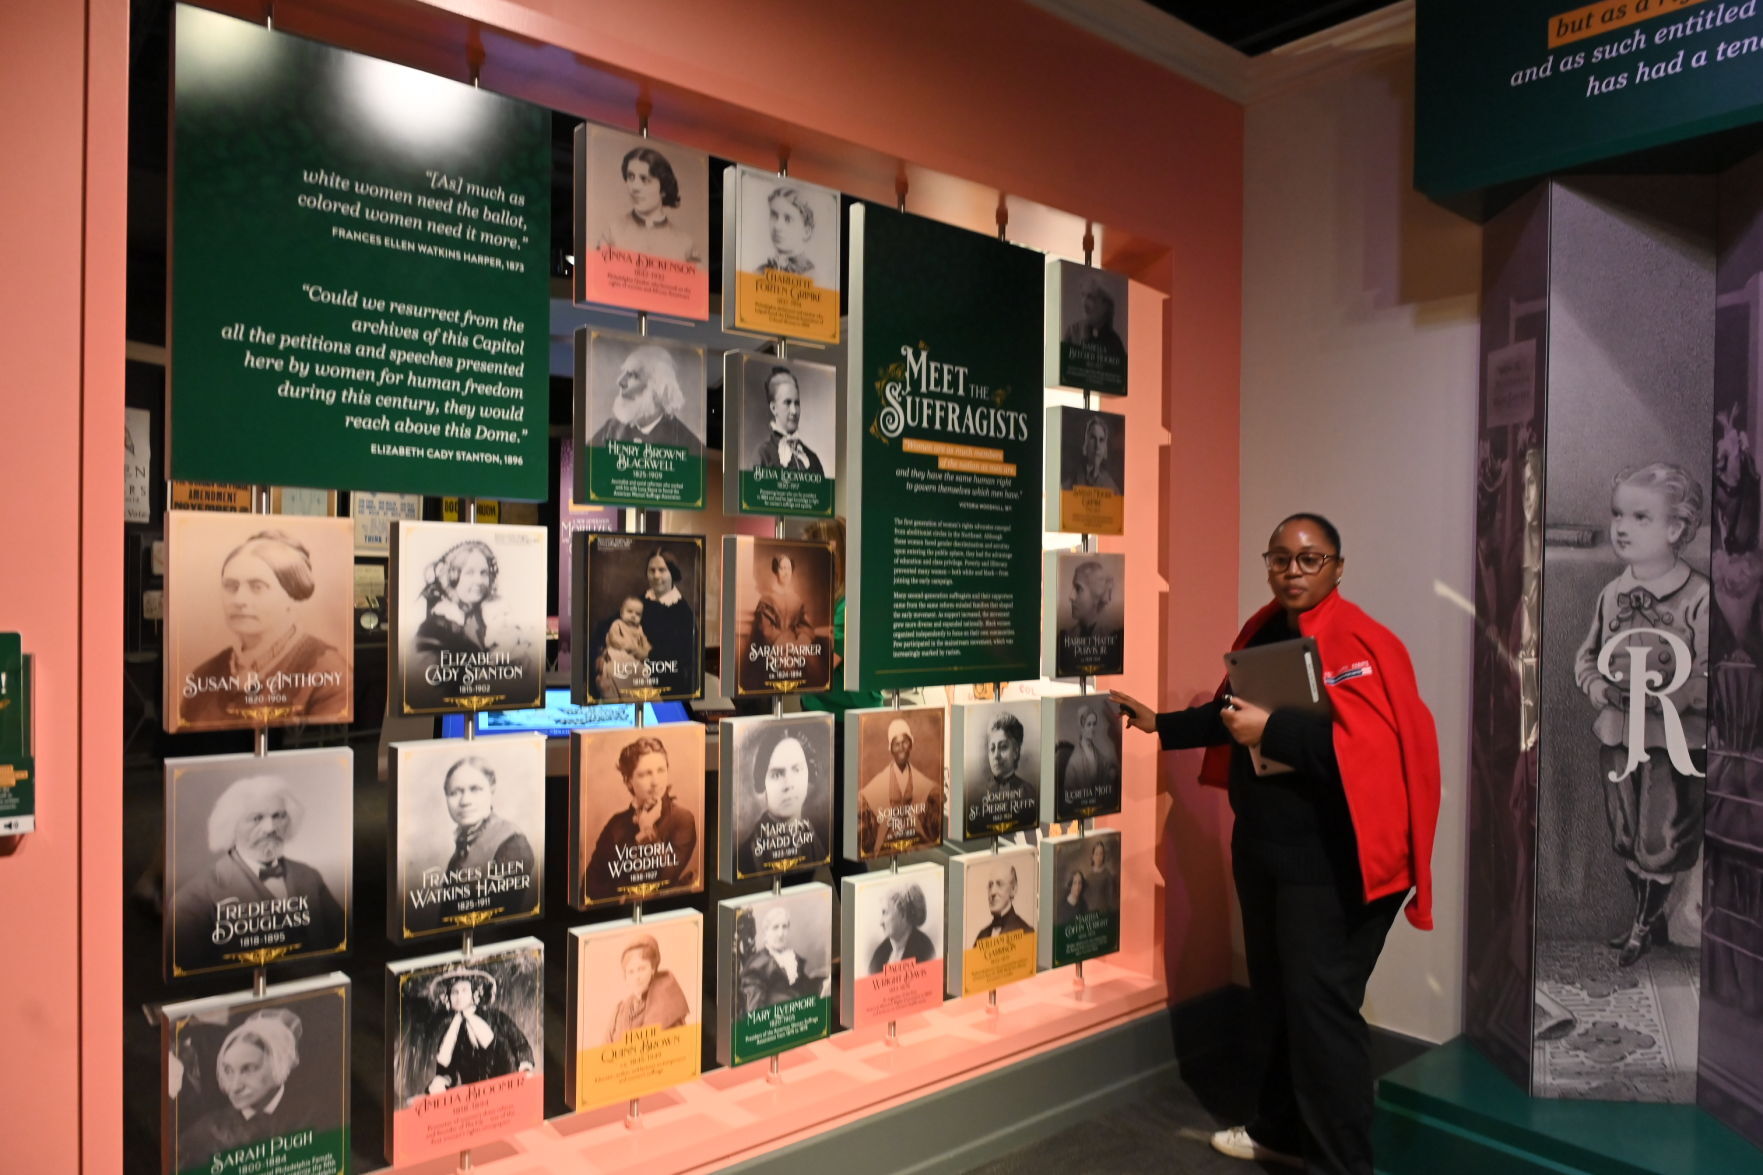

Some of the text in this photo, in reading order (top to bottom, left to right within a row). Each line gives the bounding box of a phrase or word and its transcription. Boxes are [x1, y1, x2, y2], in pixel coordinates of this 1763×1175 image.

[1556, 13, 1595, 38] but
[1600, 4, 1627, 24] as
[1511, 0, 1756, 87] and as such entitled
[1586, 75, 1628, 97] has
[1635, 50, 1684, 84] had
[1691, 50, 1708, 69] a
[303, 169, 527, 230] white women need the ballot,
[466, 183, 505, 202] much
[508, 193, 525, 206] as
[297, 194, 361, 217] colored
[364, 208, 422, 230] women
[426, 220, 462, 238] need
[465, 224, 476, 241] it
[331, 226, 524, 272] FRANCES ELLEN WATKINS HARPER, 1873
[362, 297, 385, 311] we
[389, 301, 459, 322] resurrect
[460, 309, 498, 329] from
[502, 316, 524, 333] the
[220, 323, 524, 377] all the petitions and speeches presented
[351, 320, 524, 354] archives of this Capitol
[244, 350, 523, 399] here by women for human freedom
[901, 345, 989, 400] MEET THE
[277, 380, 524, 421] during this century, they would
[880, 382, 1028, 441] SUFFRAGISTS
[345, 414, 390, 431] reach
[394, 417, 440, 436] above
[444, 421, 471, 438] this
[370, 443, 523, 466] ELIZABETH CADY STANTON, 1896
[608, 440, 641, 456] HENRY
[616, 454, 675, 471] BLACKWELL
[894, 467, 910, 477] and
[910, 467, 926, 480] they
[926, 469, 943, 480] have
[905, 480, 913, 490] to
[913, 483, 937, 493] govern
[937, 483, 971, 495] themselves
[990, 490, 1004, 498] men
[440, 650, 510, 667] ELIZABETH
[749, 643, 821, 661] SARAH PARKER
[765, 655, 806, 673] REMOND
[425, 664, 523, 684] CADY STANTON
[613, 659, 678, 679] LUCY STONE
[183, 671, 343, 698] SUSAN B. ANTHONY
[1597, 627, 1706, 784] R
[877, 804, 926, 824] SOJOURNER
[887, 816, 916, 833] TRUTH
[760, 818, 810, 838] MARY ANN
[614, 841, 674, 861] VICTORIA
[755, 831, 815, 857] SHADD CARY
[422, 860, 524, 888] FRANCES ELLEN
[608, 854, 679, 879] WOODHULL
[409, 875, 531, 909] WATKINS HARPER
[215, 896, 309, 921] FREDERICK
[211, 912, 311, 945] DOUGLASS
[747, 1009, 770, 1027] MARY
[774, 995, 816, 1019] LIVERMORE
[211, 1143, 265, 1175] SARAH
[271, 1130, 313, 1156] PUGH
